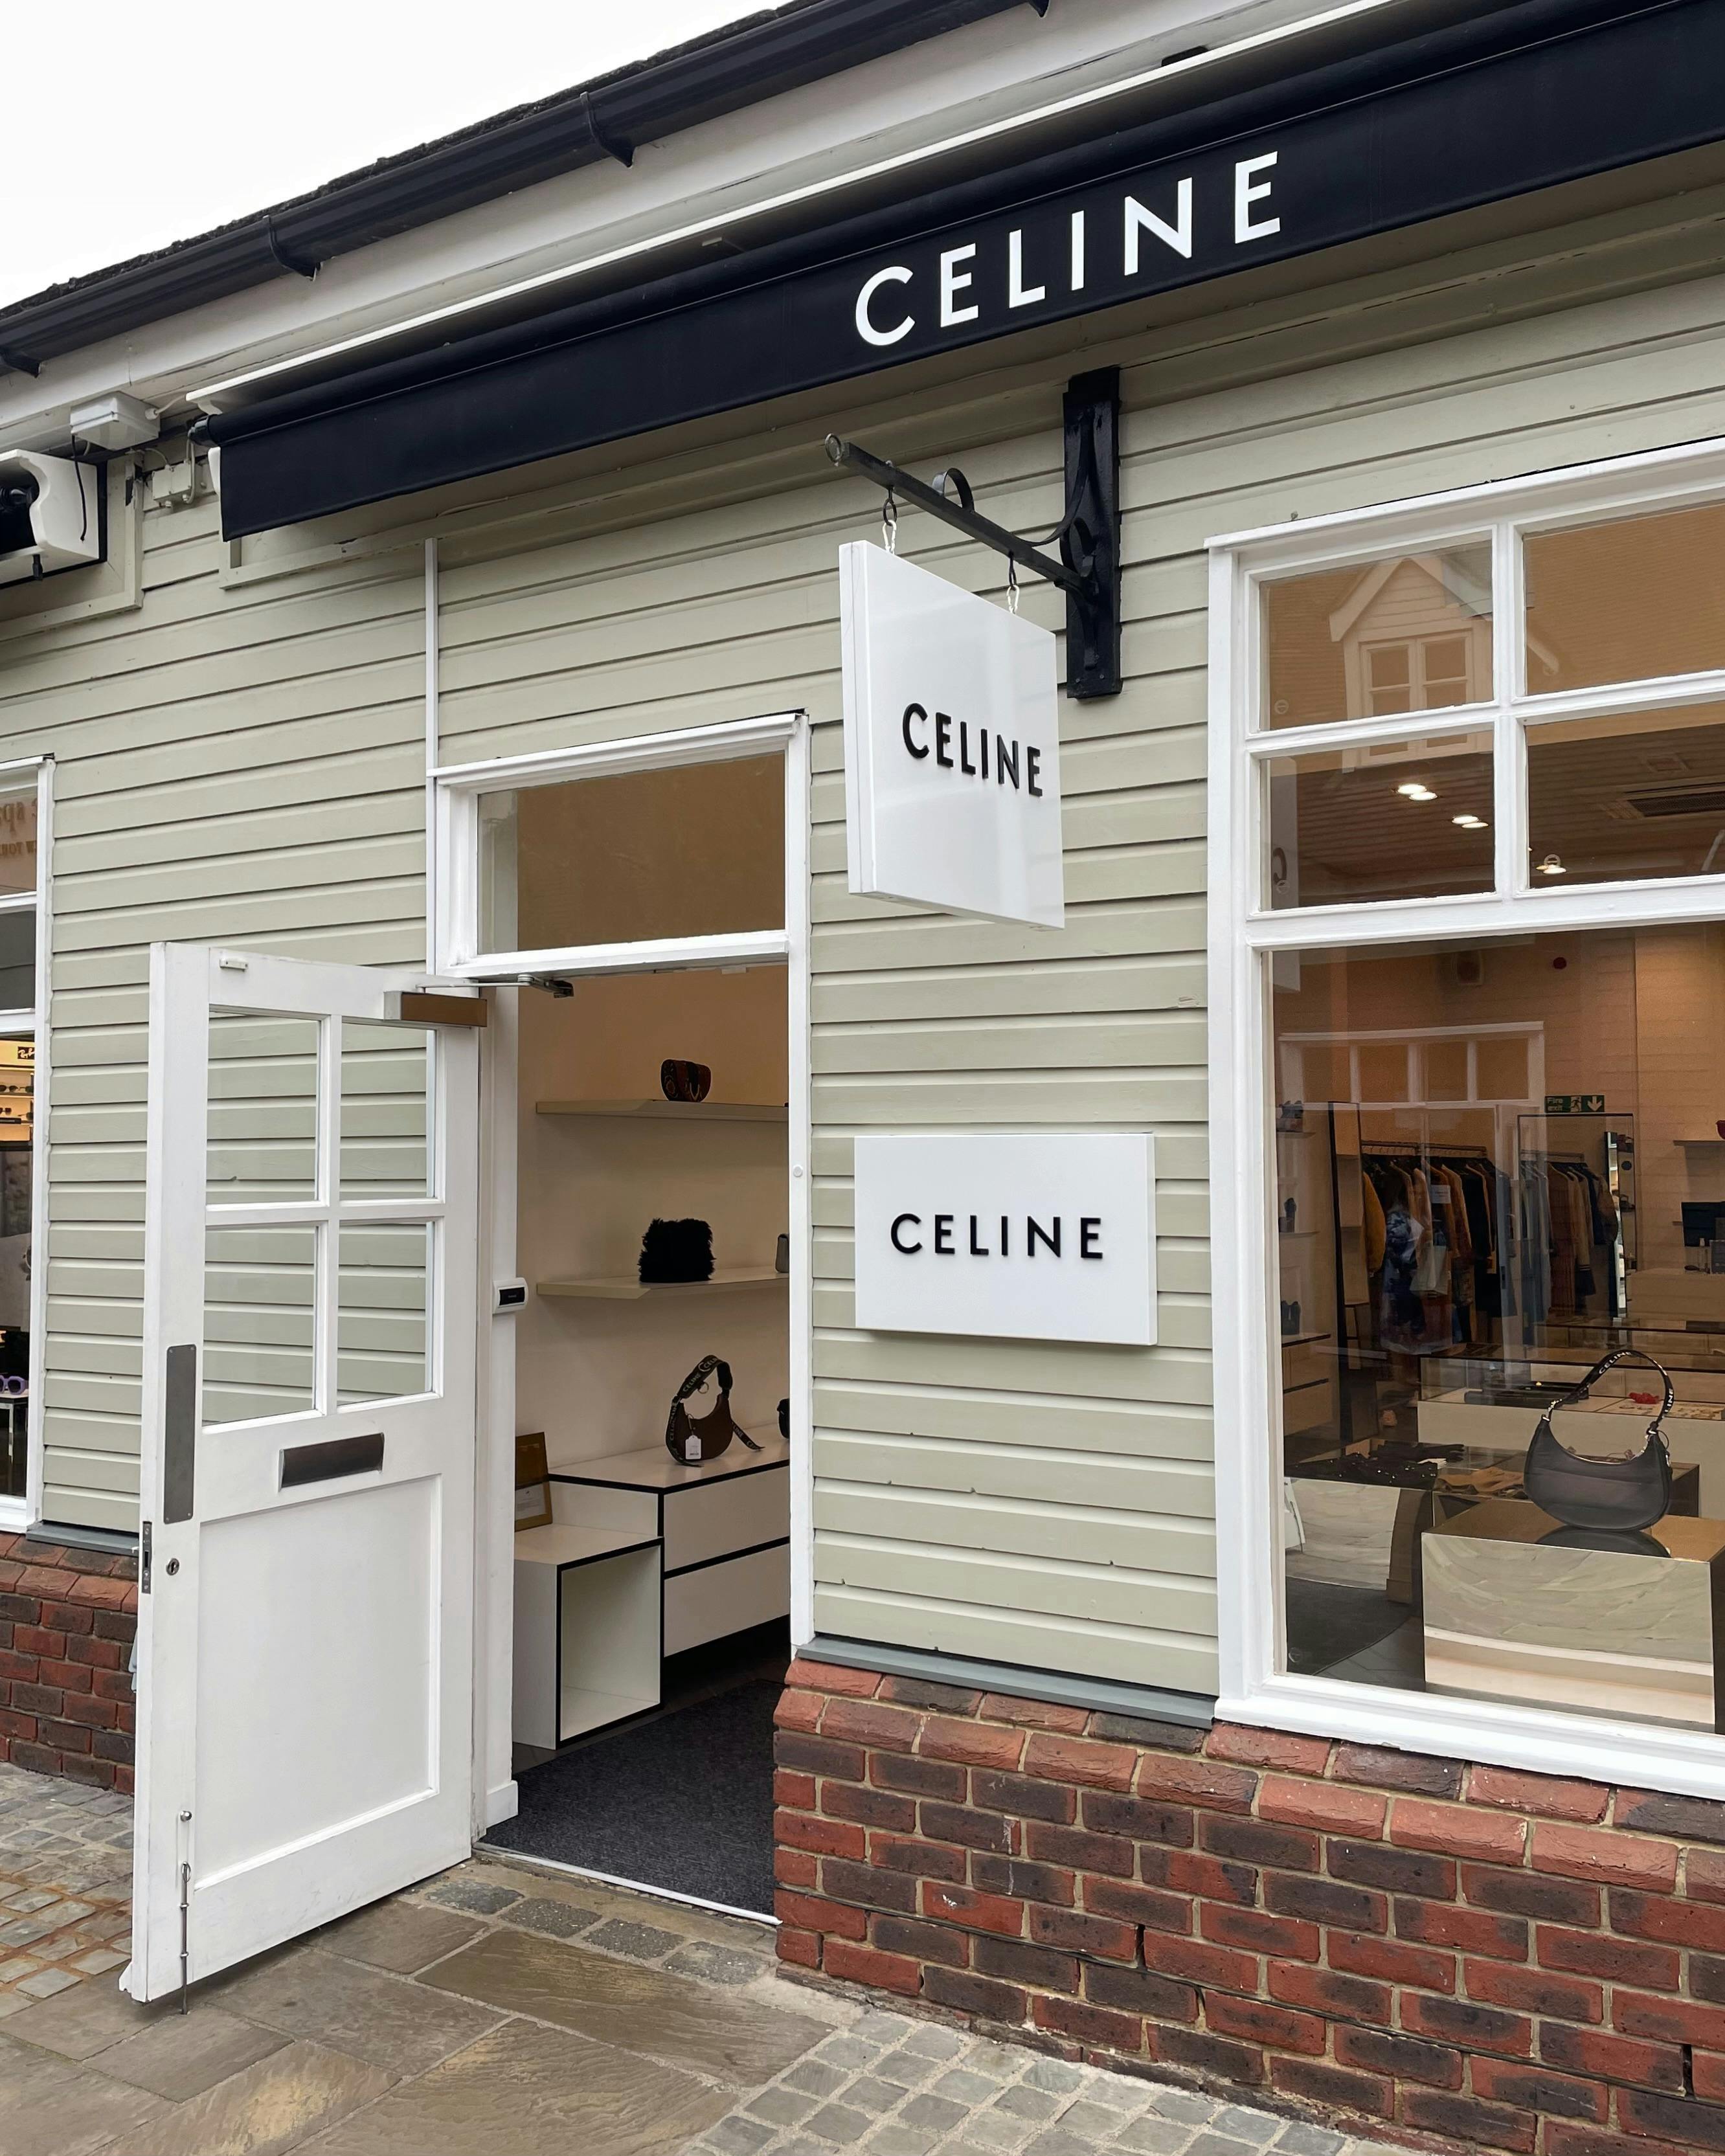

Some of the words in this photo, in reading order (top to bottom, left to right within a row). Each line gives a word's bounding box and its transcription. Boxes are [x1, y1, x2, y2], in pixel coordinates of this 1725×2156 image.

[855, 150, 1281, 346] CELINE
[902, 702, 1043, 798] CELINE
[890, 1213, 1103, 1260] CELINE
[1599, 1351, 1632, 1375] CELINE
